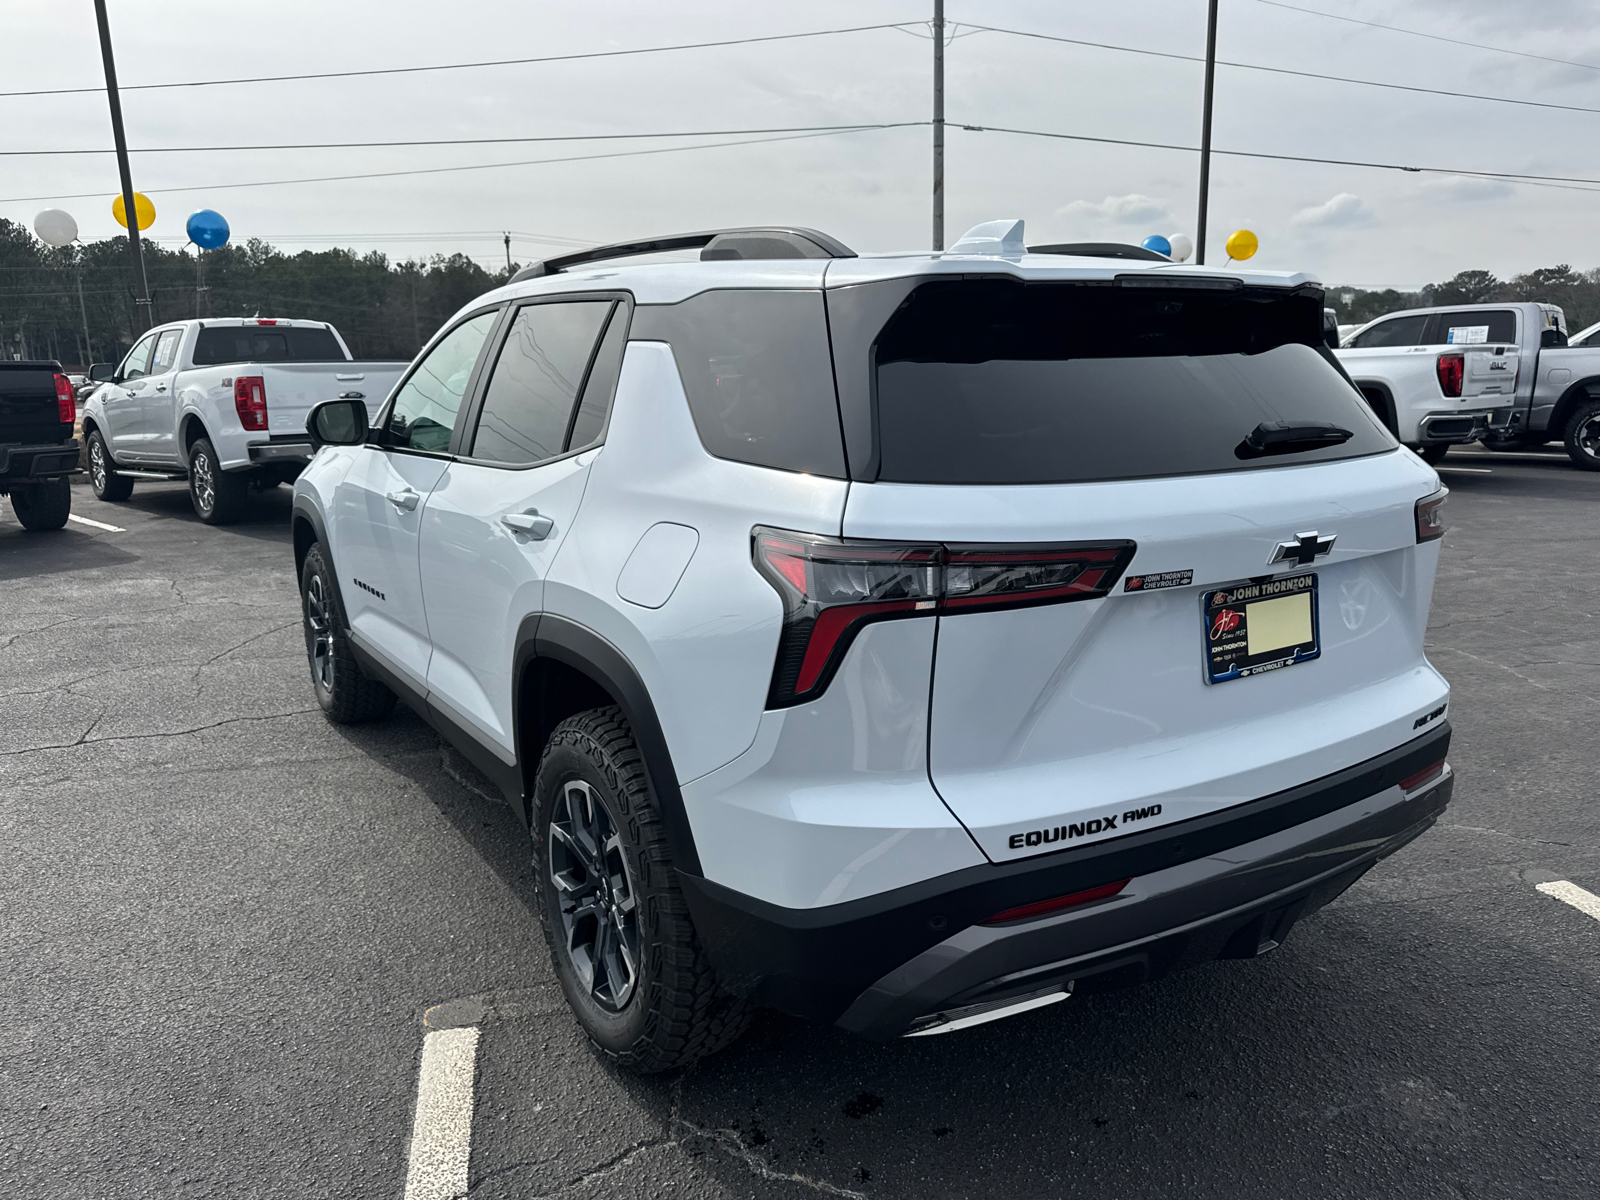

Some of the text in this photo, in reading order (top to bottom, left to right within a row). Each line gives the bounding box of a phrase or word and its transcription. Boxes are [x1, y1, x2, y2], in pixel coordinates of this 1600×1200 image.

[1144, 574, 1160, 583] JOHN
[1161, 571, 1192, 581] THORNTON
[1143, 579, 1180, 589] CHEVROLET
[1232, 586, 1260, 601] JOHN
[1261, 575, 1313, 595] THORNTON
[1211, 641, 1247, 654] JOHN THORNTON
[1252, 660, 1284, 674] CHEVROLET
[1008, 803, 1162, 849] EQUINOX AWD
